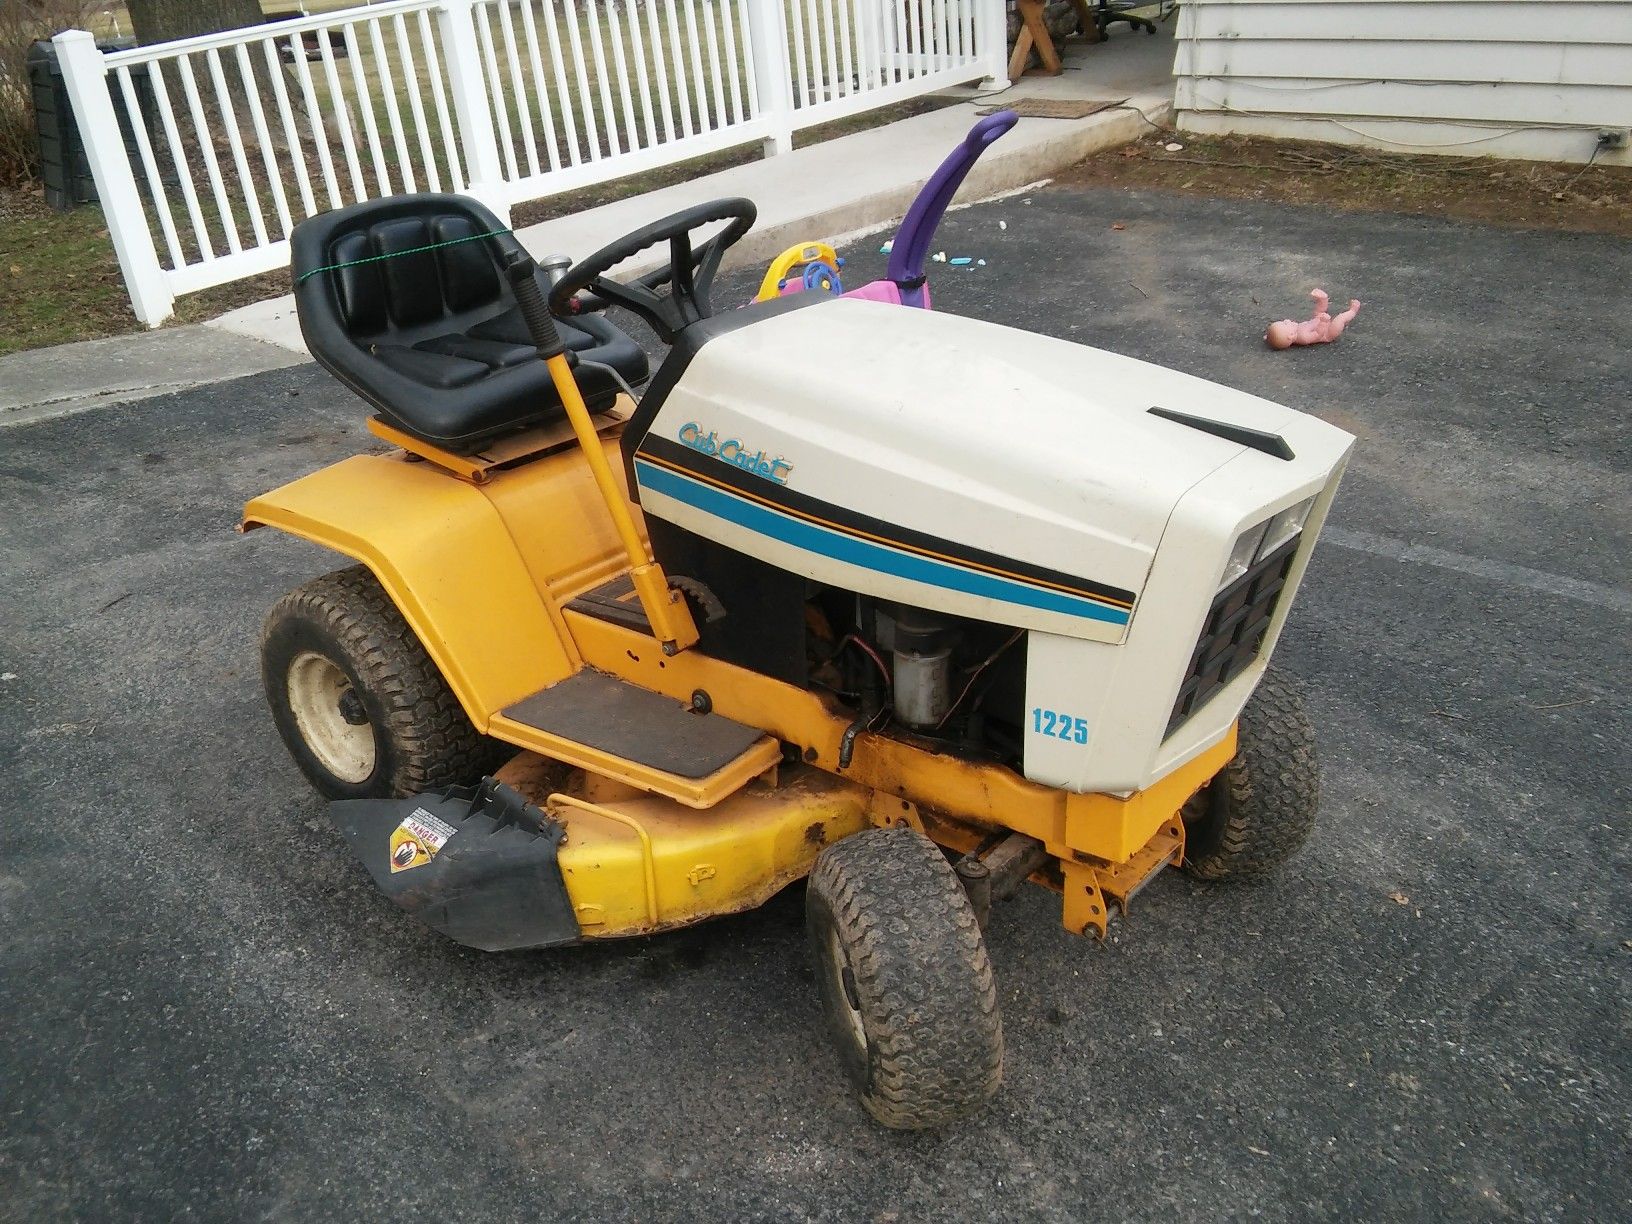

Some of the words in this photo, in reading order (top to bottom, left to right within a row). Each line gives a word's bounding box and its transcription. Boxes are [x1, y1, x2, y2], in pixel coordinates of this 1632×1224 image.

[679, 421, 718, 455] Cub
[719, 438, 794, 485] Cadet
[1032, 707, 1088, 745] 1225
[408, 821, 440, 845] DANGER
